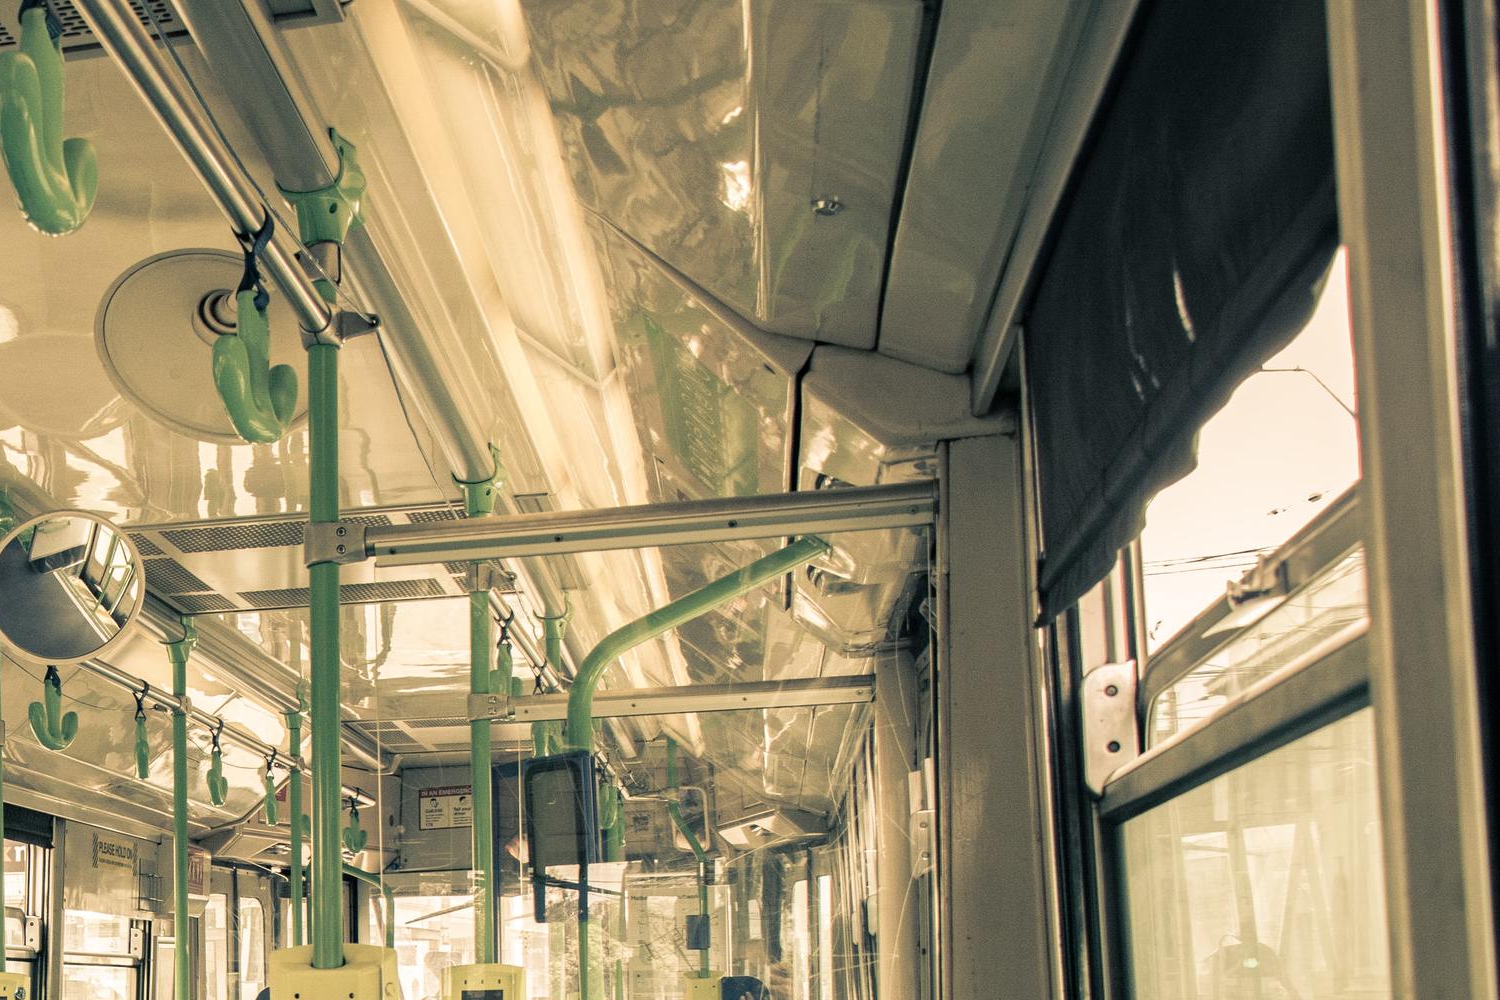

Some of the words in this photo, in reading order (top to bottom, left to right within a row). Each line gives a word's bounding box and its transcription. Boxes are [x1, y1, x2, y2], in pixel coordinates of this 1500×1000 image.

[439, 788, 473, 796] EMERGENC
[99, 841, 114, 855] PLEASE
[115, 845, 126, 858] HOLD
[126, 847, 133, 859] ON
